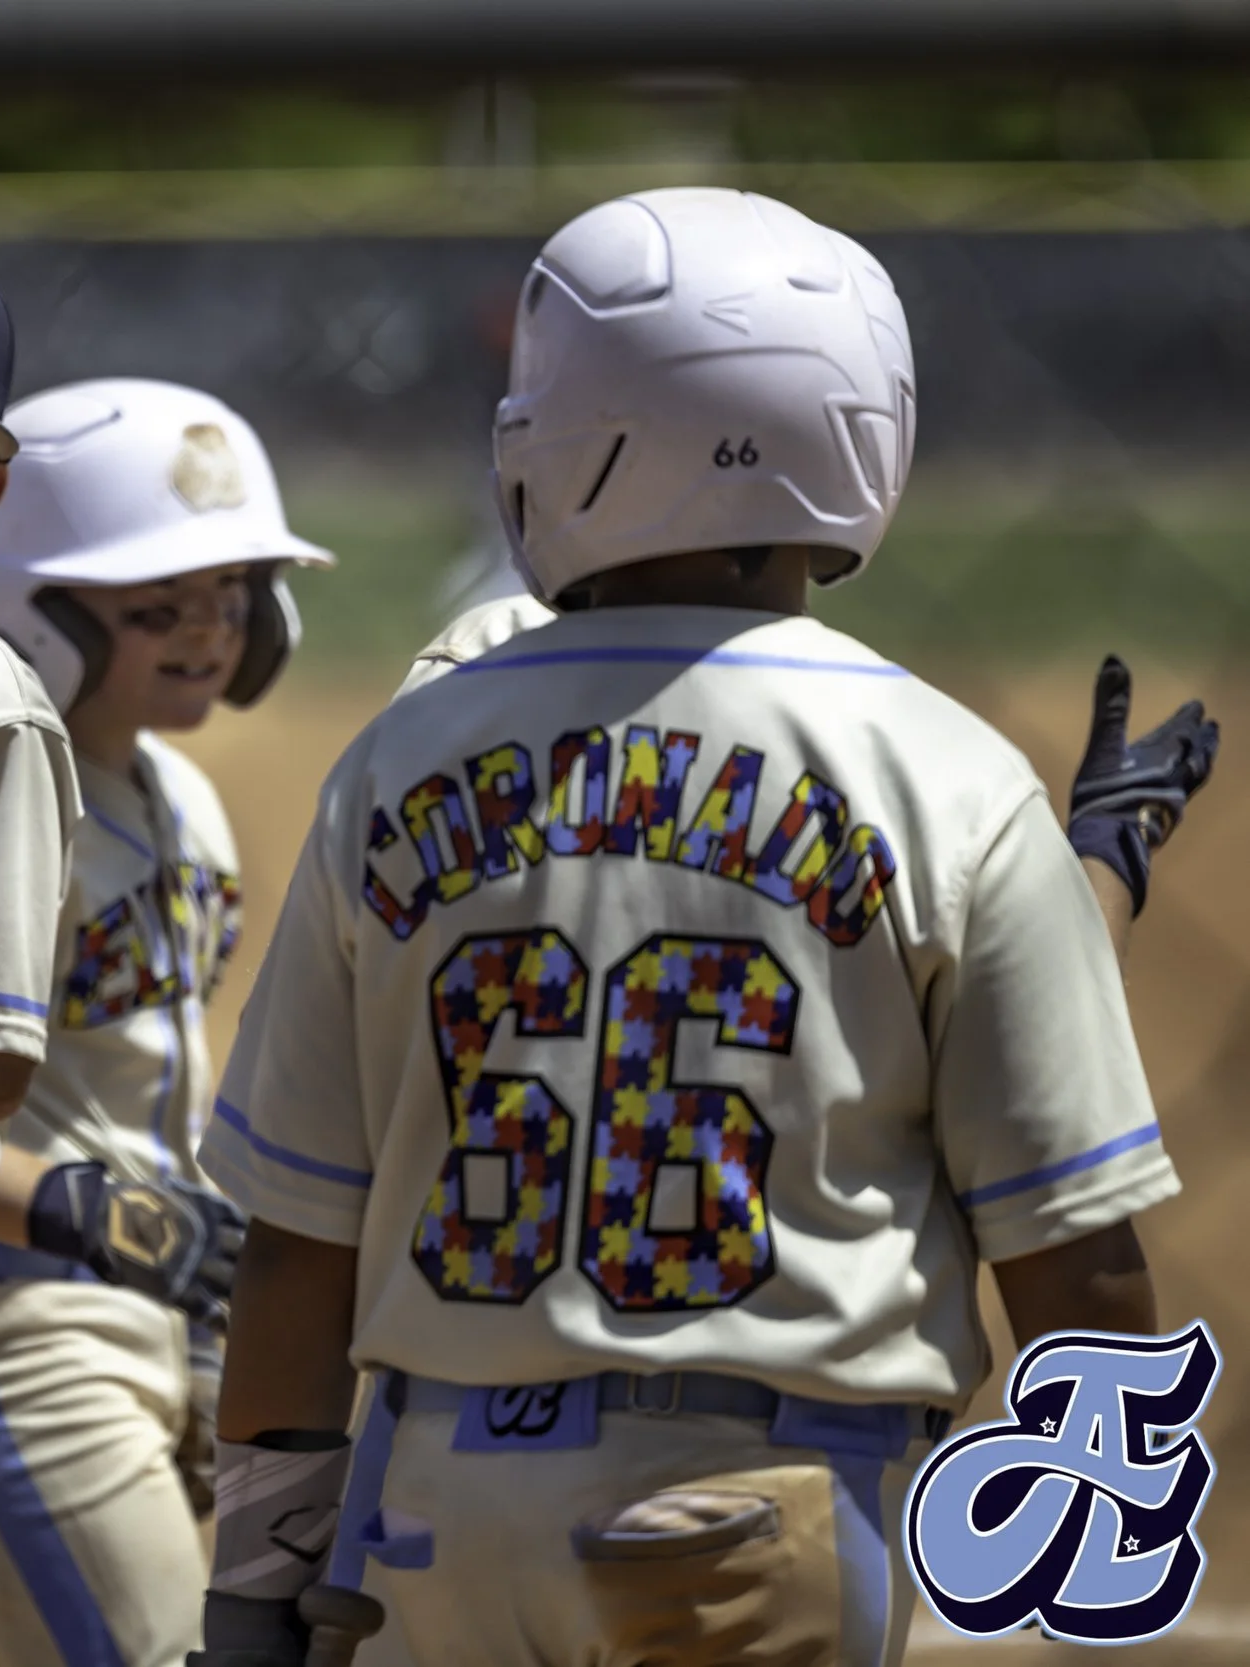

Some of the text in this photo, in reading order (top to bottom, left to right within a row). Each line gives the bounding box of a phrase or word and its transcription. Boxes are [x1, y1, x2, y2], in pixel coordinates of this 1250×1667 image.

[712, 436, 760, 468] 66
[361, 723, 896, 948] CORONADO
[410, 926, 801, 1314] 66
